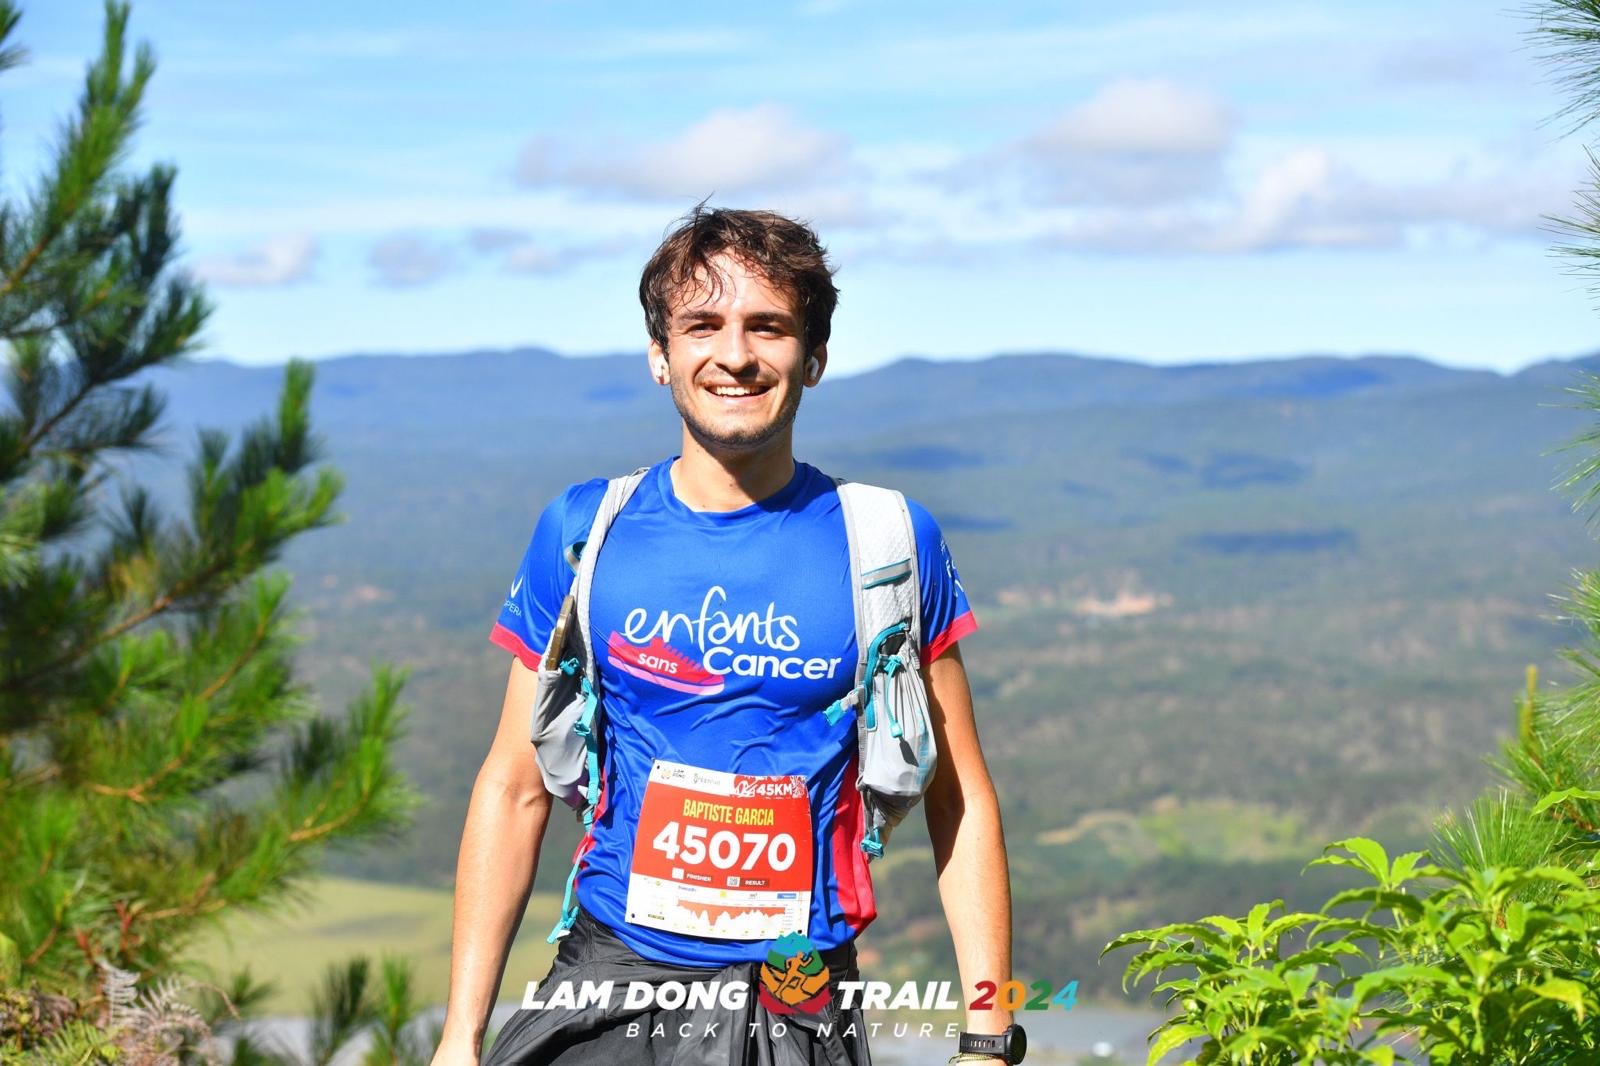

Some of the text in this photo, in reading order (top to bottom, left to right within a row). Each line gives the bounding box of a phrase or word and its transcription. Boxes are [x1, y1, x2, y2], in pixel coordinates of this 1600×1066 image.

[619, 585, 801, 653] enfants
[637, 651, 678, 675] sans
[702, 646, 842, 680] Cancer
[756, 783, 793, 796] 45KM
[683, 799, 774, 826] BAPTISTE GARCIA
[653, 821, 796, 872] 45070
[686, 873, 712, 882] FINISHER
